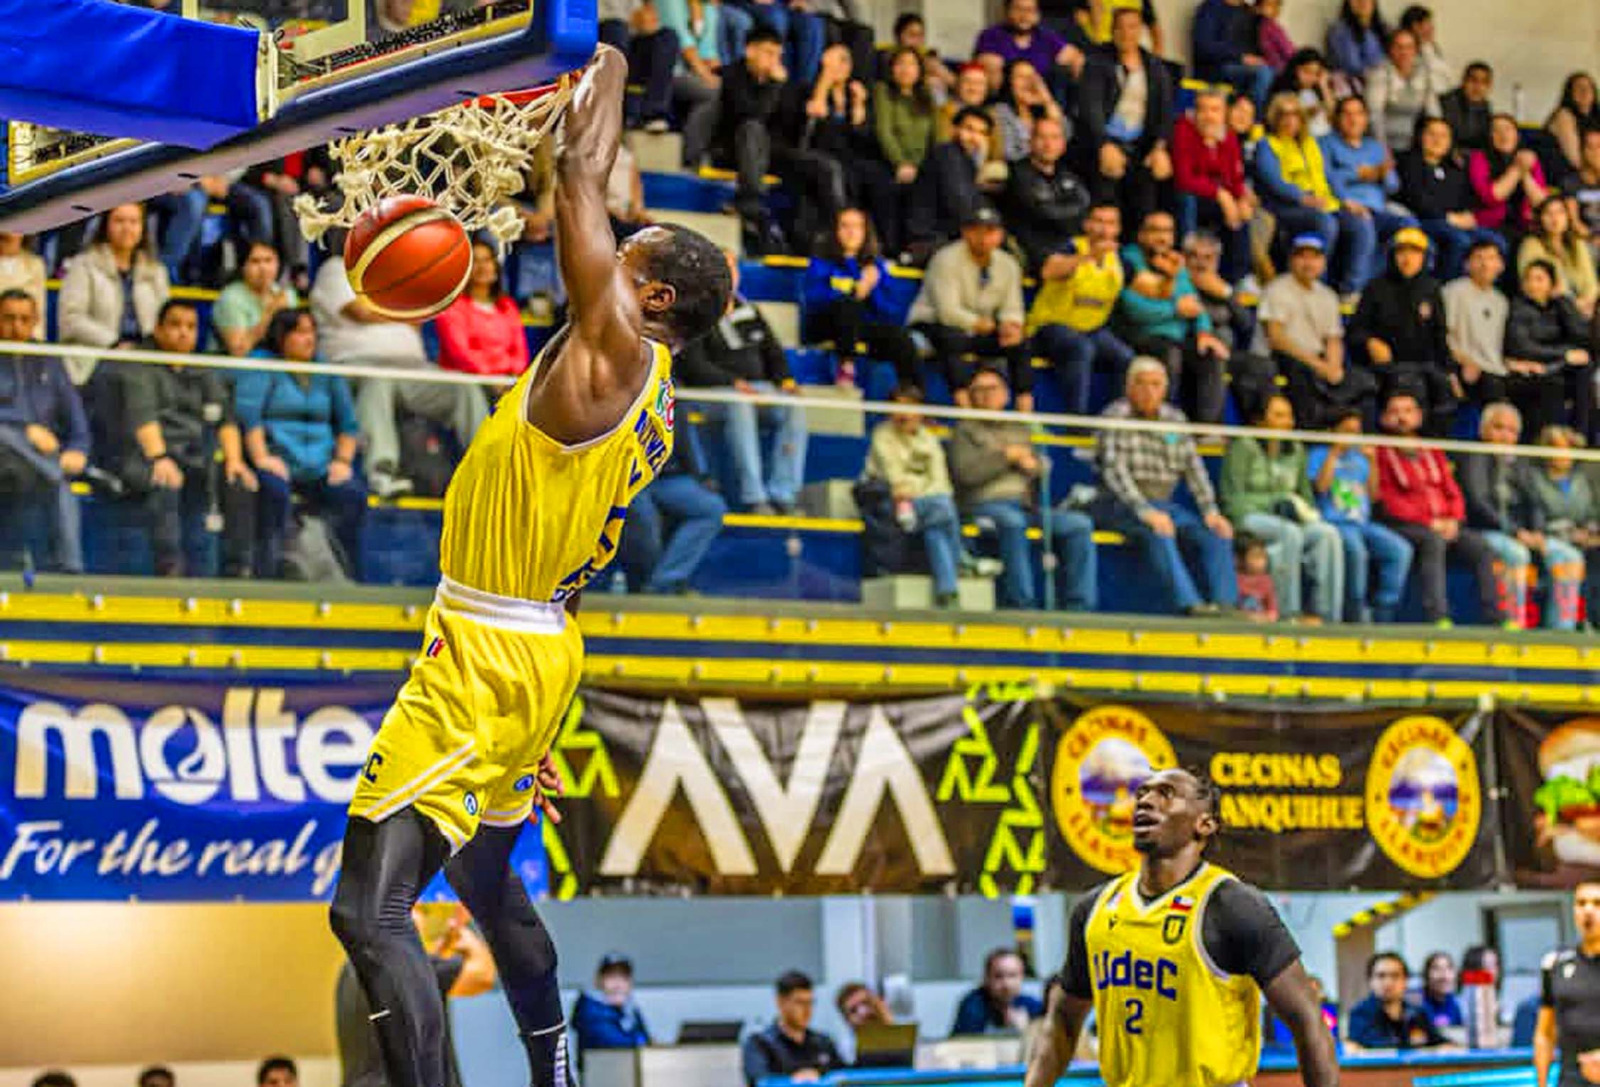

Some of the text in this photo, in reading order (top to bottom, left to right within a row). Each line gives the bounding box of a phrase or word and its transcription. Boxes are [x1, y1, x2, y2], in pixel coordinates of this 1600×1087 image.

[14, 687, 374, 805] molte
[1210, 752, 1342, 788] CECINAS
[1220, 793, 1364, 833] ANQUIHUE
[1, 820, 88, 878] For
[97, 819, 191, 877] the
[196, 818, 318, 877] real
[1094, 949, 1178, 1001] UdeC
[1125, 999, 1143, 1034] 2
